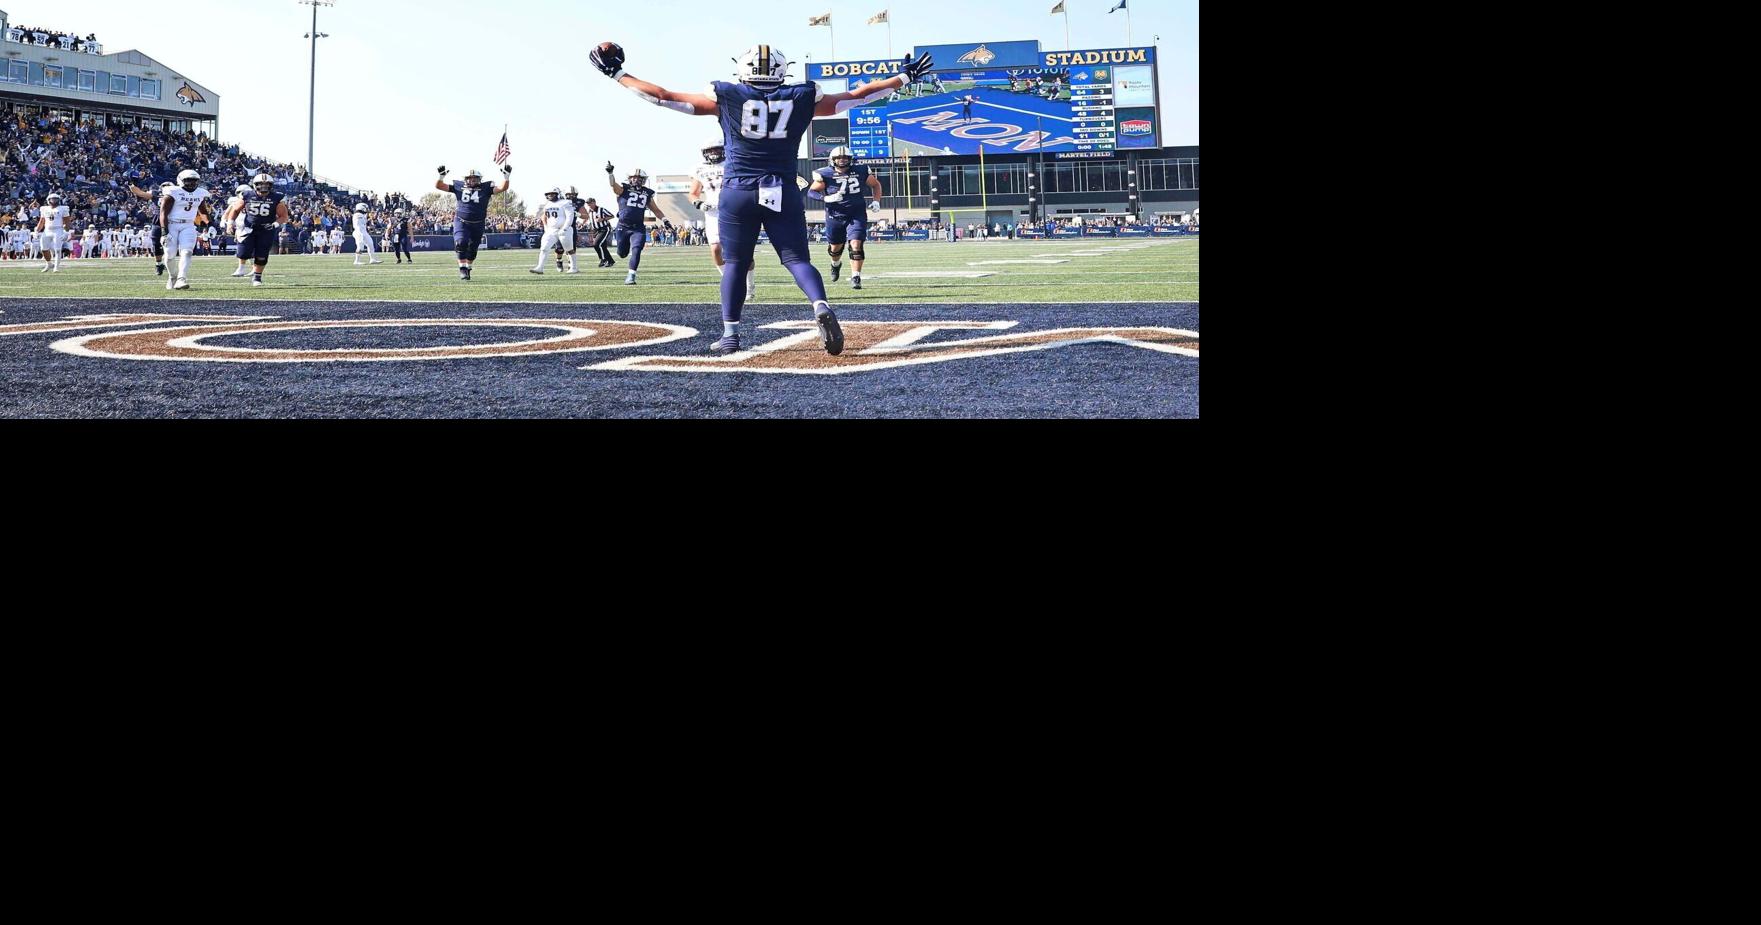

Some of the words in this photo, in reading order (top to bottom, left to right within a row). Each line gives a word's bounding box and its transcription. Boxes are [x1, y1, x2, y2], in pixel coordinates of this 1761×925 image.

[1046, 50, 1146, 66] STADIUM
[821, 62, 901, 77] BOBCAT
[741, 100, 794, 139] 87
[857, 116, 881, 124] 9:56
[892, 111, 1073, 151] MON
[836, 177, 860, 194] 72
[461, 189, 480, 203] 64
[626, 191, 647, 208] 23
[184, 201, 193, 211] 3
[249, 202, 270, 217] 56
